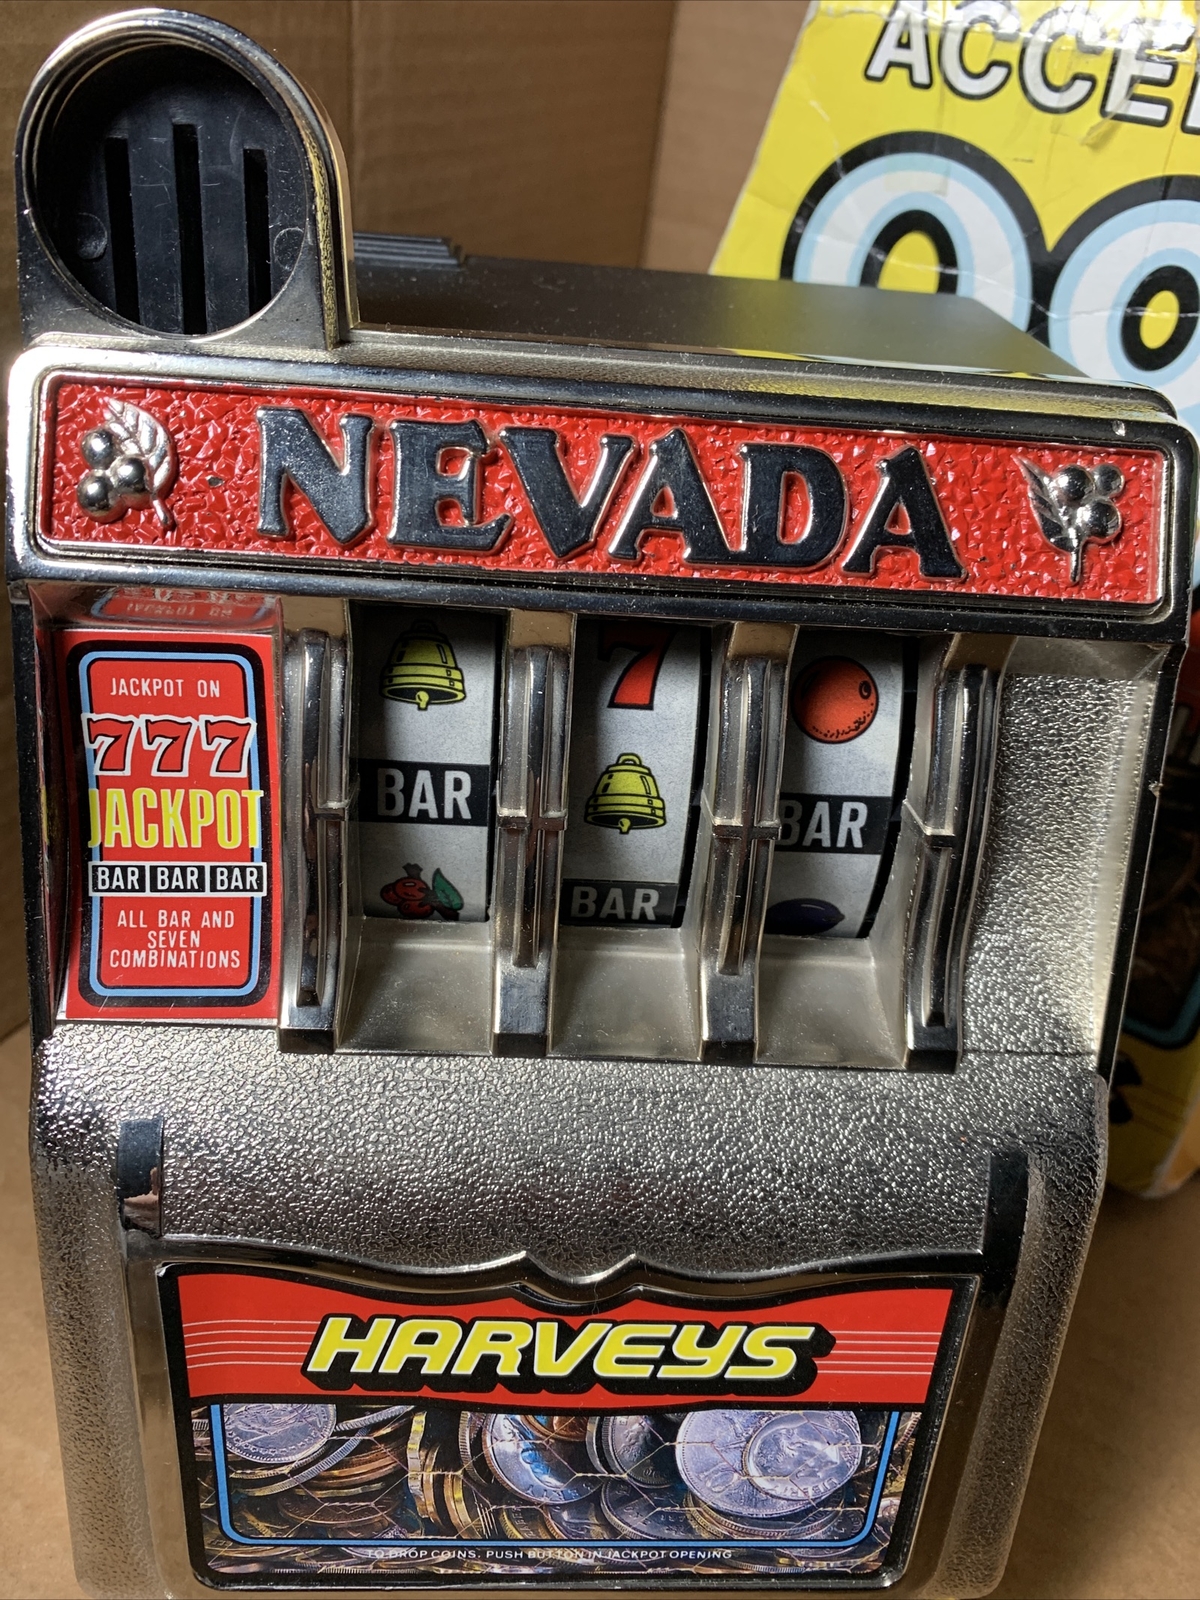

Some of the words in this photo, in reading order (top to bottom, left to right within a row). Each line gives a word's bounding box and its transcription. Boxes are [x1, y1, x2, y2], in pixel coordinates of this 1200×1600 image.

[863, 0, 1200, 135] ACCE
[255, 407, 967, 582] NEVADA
[110, 678, 184, 697] JACKPOT
[197, 680, 221, 698] ON
[81, 713, 257, 777] 777
[377, 767, 472, 820] BAR
[87, 787, 265, 850] JACKPOT
[777, 800, 868, 849] BAR
[96, 866, 140, 891] BAR
[157, 867, 200, 891] BAR
[216, 867, 260, 891] BAR
[117, 910, 147, 928] ALL
[158, 910, 191, 928] BAR
[201, 911, 235, 929] AND
[569, 886, 659, 922] BAR
[109, 949, 241, 969] COMBINATIONS
[147, 930, 201, 948] SEVEN
[305, 1315, 816, 1381] HARVEYS
[367, 1550, 385, 1558] TO
[388, 1550, 428, 1558] DROP
[431, 1550, 481, 1559] COINS.
[486, 1550, 523, 1559] PUSH
[528, 1550, 584, 1559] BUTTON
[588, 1550, 602, 1559] IN
[606, 1550, 666, 1559] JACKPOT
[669, 1550, 732, 1559] OPENING
